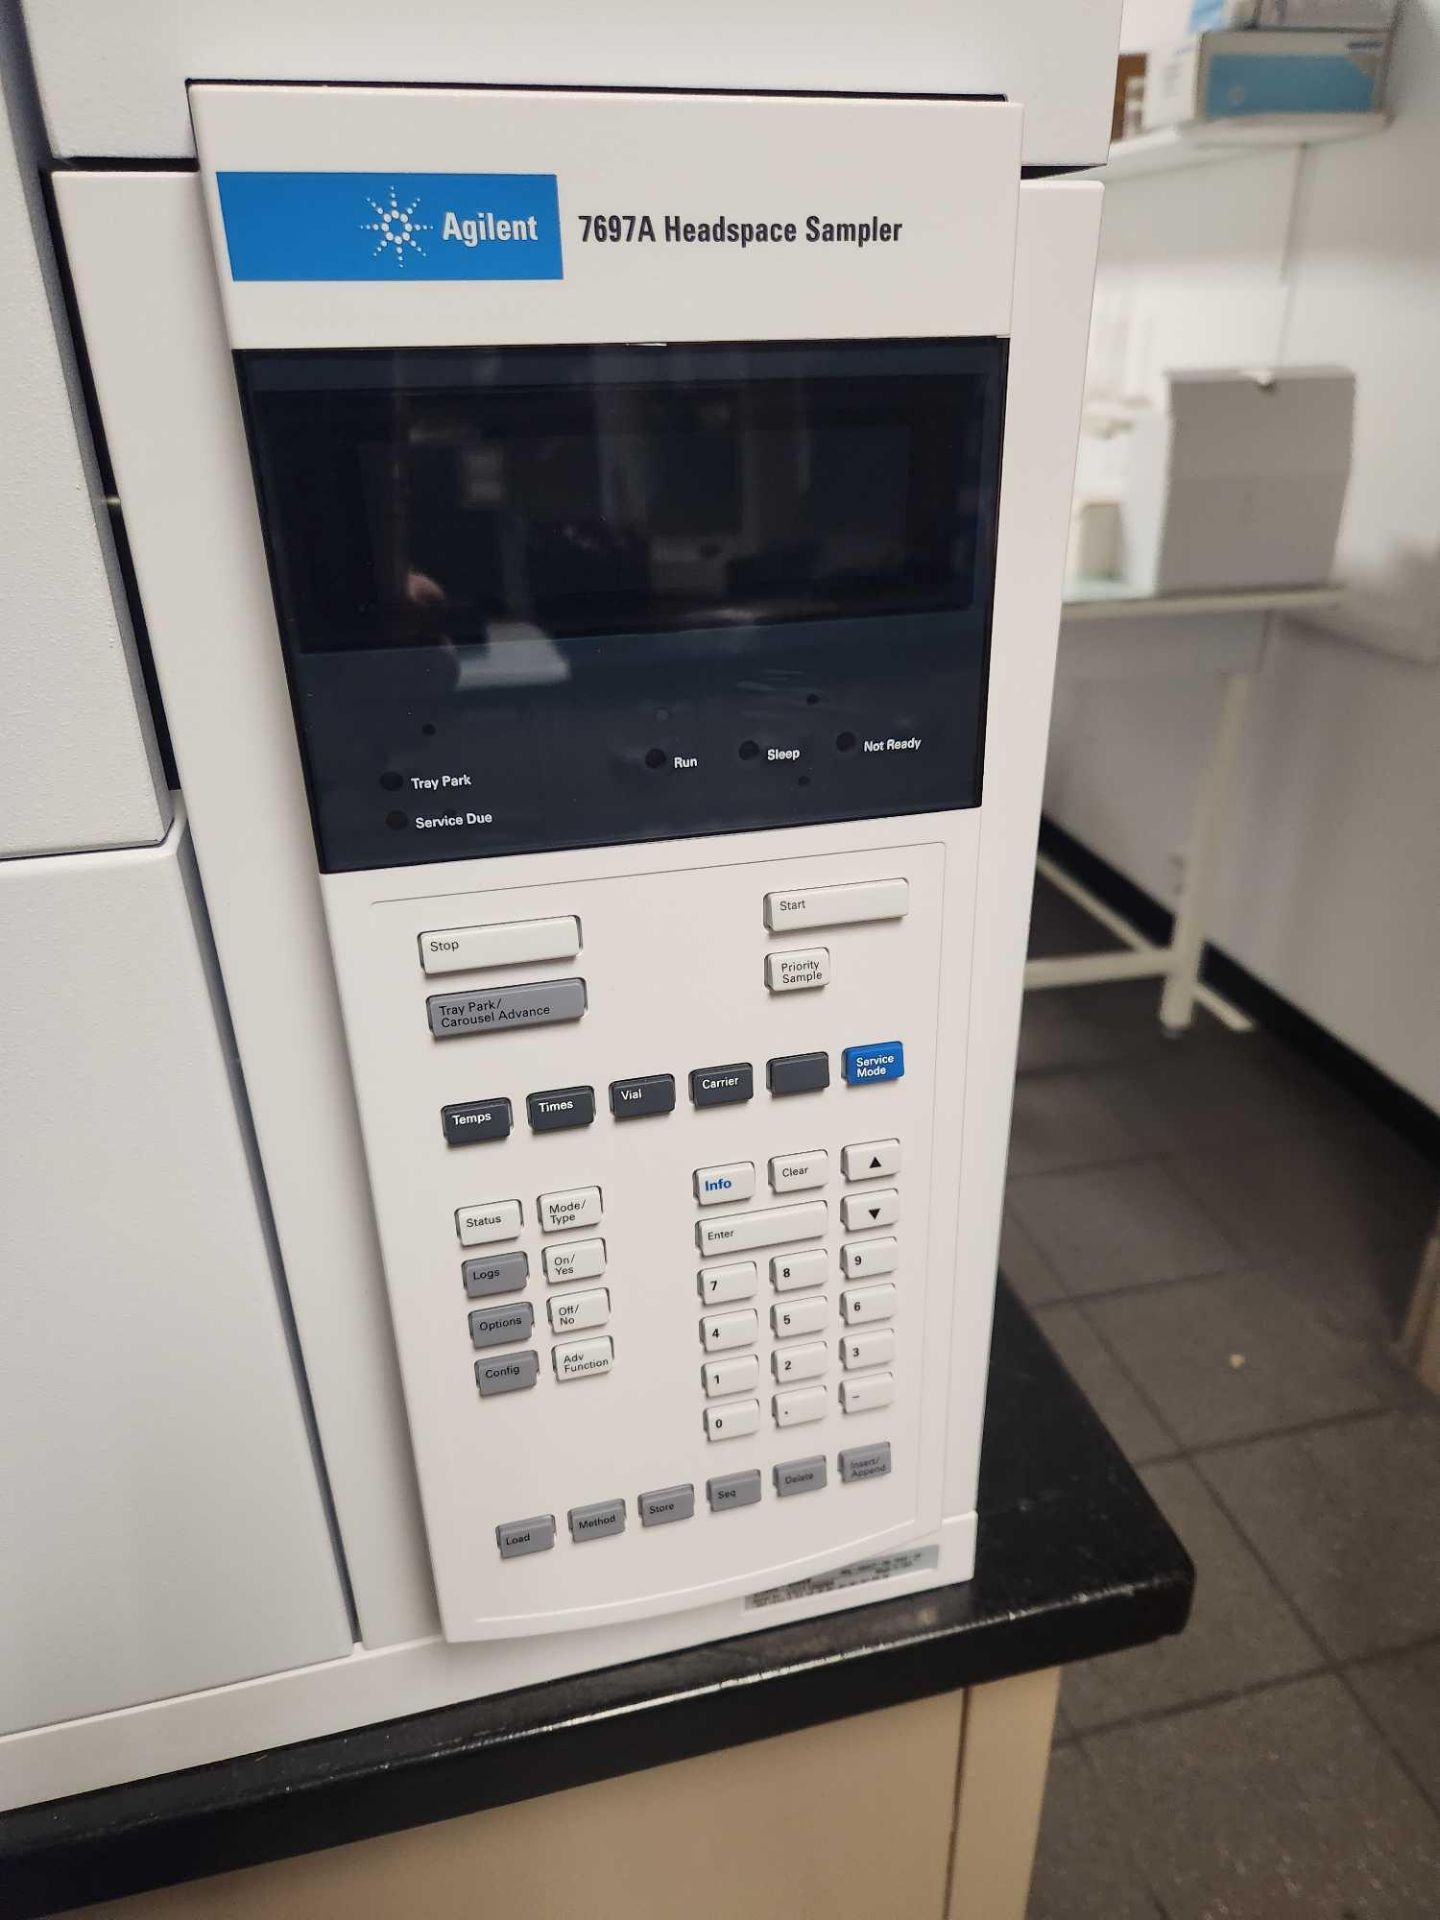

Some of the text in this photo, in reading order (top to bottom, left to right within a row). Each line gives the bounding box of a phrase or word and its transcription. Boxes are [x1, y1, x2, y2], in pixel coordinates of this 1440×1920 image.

[442, 211, 538, 247] Agilent
[578, 215, 903, 248] 7697A Headspace Sampler
[864, 737, 921, 753] Not Ready
[767, 748, 800, 763] Sleep
[674, 756, 697, 769] Run
[411, 775, 471, 791] Tray Park
[415, 812, 493, 829] Service Due
[779, 900, 806, 911] Start
[430, 940, 459, 953] Stop
[781, 960, 820, 974] Priority
[782, 970, 822, 984] Sample
[439, 999, 501, 1016] Tray Park/
[441, 1005, 550, 1028] Carousel Advance
[856, 1054, 894, 1068] Service
[857, 1065, 886, 1078] Mode
[702, 1076, 739, 1089] Carrier
[621, 1089, 642, 1100] Vial
[538, 1099, 573, 1112] Times
[453, 1112, 492, 1126] Temps
[782, 1165, 808, 1178] Clear
[705, 1178, 732, 1191] Info
[549, 1200, 586, 1214] Mode/
[466, 1214, 502, 1227] Status
[550, 1211, 576, 1225] Type
[708, 1229, 734, 1240] Enter
[554, 1254, 575, 1267] On/
[855, 1255, 861, 1265] 9
[472, 1267, 500, 1282] Logs
[555, 1264, 574, 1276] Yes
[783, 1267, 791, 1278] 8
[710, 1280, 718, 1291] 7
[558, 1304, 579, 1317] Off/
[854, 1301, 861, 1311] 6
[479, 1315, 522, 1331] Options
[560, 1315, 575, 1325] No
[783, 1315, 791, 1325] 5
[712, 1328, 719, 1338] 4
[564, 1352, 584, 1364] Adv
[853, 1348, 859, 1357] 3
[486, 1364, 520, 1379] Config
[564, 1357, 609, 1374] Function
[785, 1361, 791, 1370] 2
[714, 1375, 720, 1384] 1
[715, 1419, 722, 1429] 0
[785, 1471, 814, 1485] Delete
[718, 1489, 736, 1500] Seq
[649, 1502, 674, 1515] Store
[579, 1514, 616, 1530] Method
[506, 1532, 531, 1545] Load
